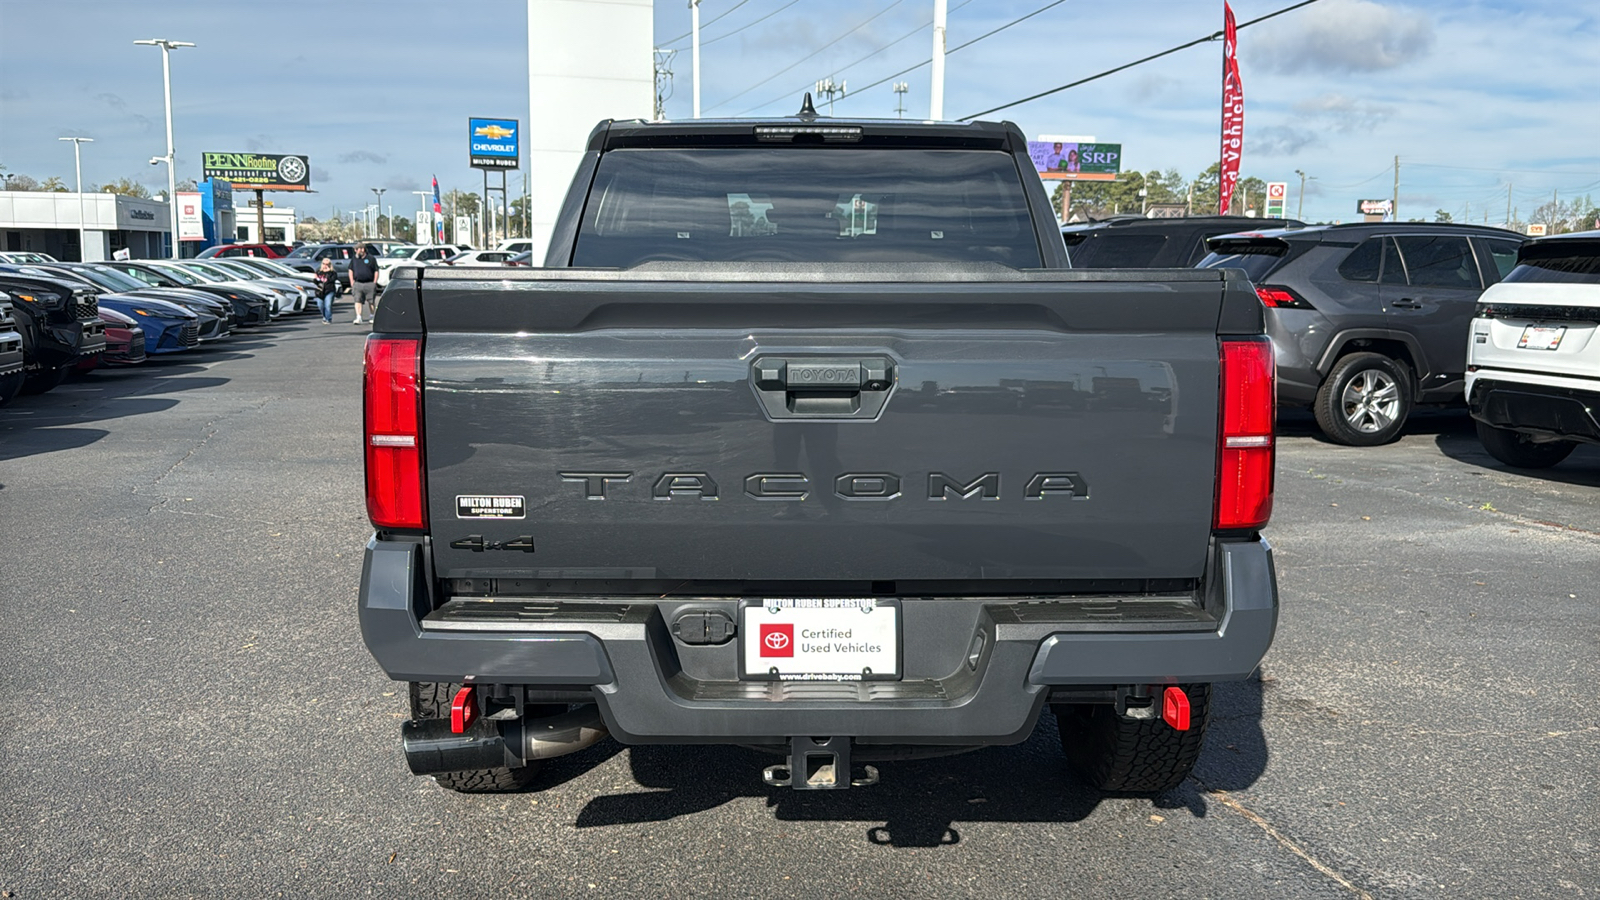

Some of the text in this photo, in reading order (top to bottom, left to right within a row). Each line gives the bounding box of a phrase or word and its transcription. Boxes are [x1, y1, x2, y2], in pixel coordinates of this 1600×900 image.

[473, 143, 515, 152] CHEVROLET
[204, 153, 248, 167] PENN
[247, 156, 277, 170] Roofing
[1081, 152, 1118, 164] SRP
[790, 369, 858, 382] TOYOTA
[557, 471, 1091, 500] TACOMA
[460, 498, 522, 508] MILTON RUBEN
[449, 534, 535, 553] 4x4
[763, 598, 877, 608] MILTON RUBEN SUPERSTORE
[801, 628, 852, 639] Certified
[801, 642, 882, 653] Used Vehicles
[779, 673, 862, 682] www.drivebaby.com
